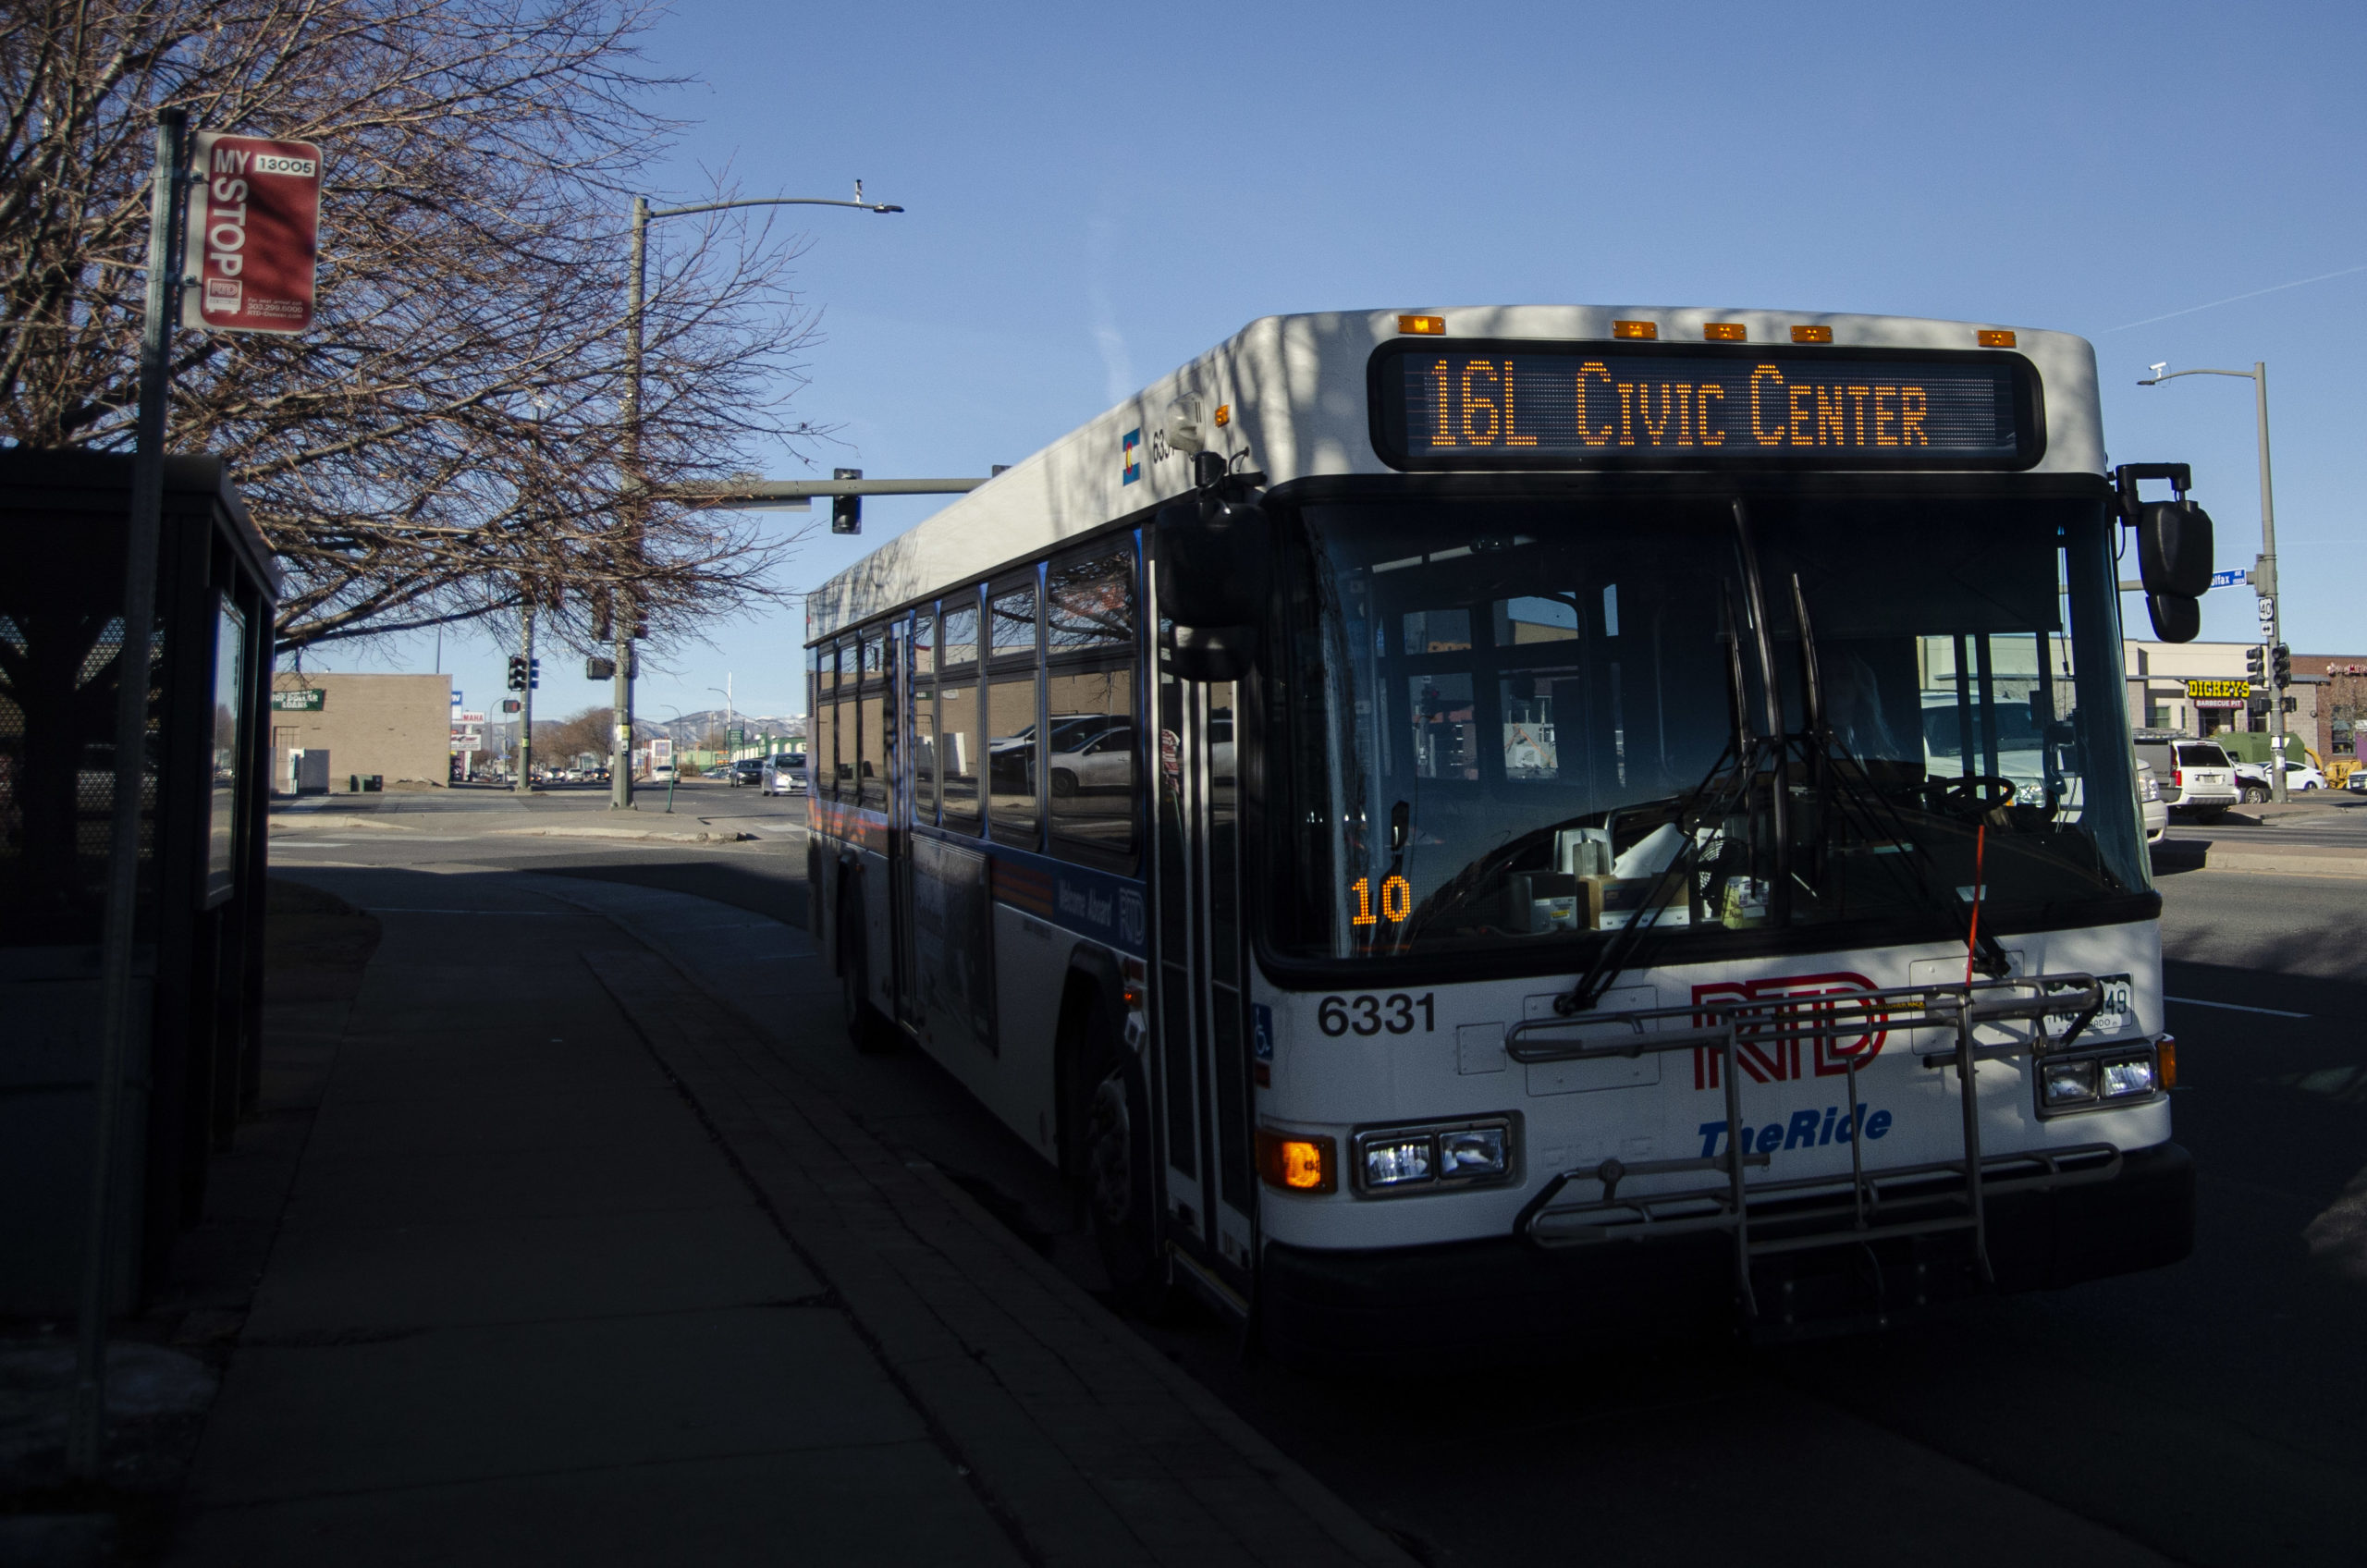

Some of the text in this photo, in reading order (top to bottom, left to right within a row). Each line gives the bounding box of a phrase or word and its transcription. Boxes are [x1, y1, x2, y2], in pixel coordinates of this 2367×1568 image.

[215, 149, 251, 175] MY
[259, 157, 313, 174] 13005
[210, 177, 250, 276] STOP
[212, 282, 238, 296] RTD
[1431, 359, 1538, 446] 16L
[1153, 429, 1175, 464] 63
[2211, 574, 2230, 586] olfax
[2260, 603, 2272, 616] 40
[1118, 887, 1147, 946] RTD
[1351, 875, 1411, 925] 10
[1318, 992, 1435, 1037] 6331
[1692, 972, 1888, 1090] RTD
[1699, 1103, 1892, 1158] TheRide
